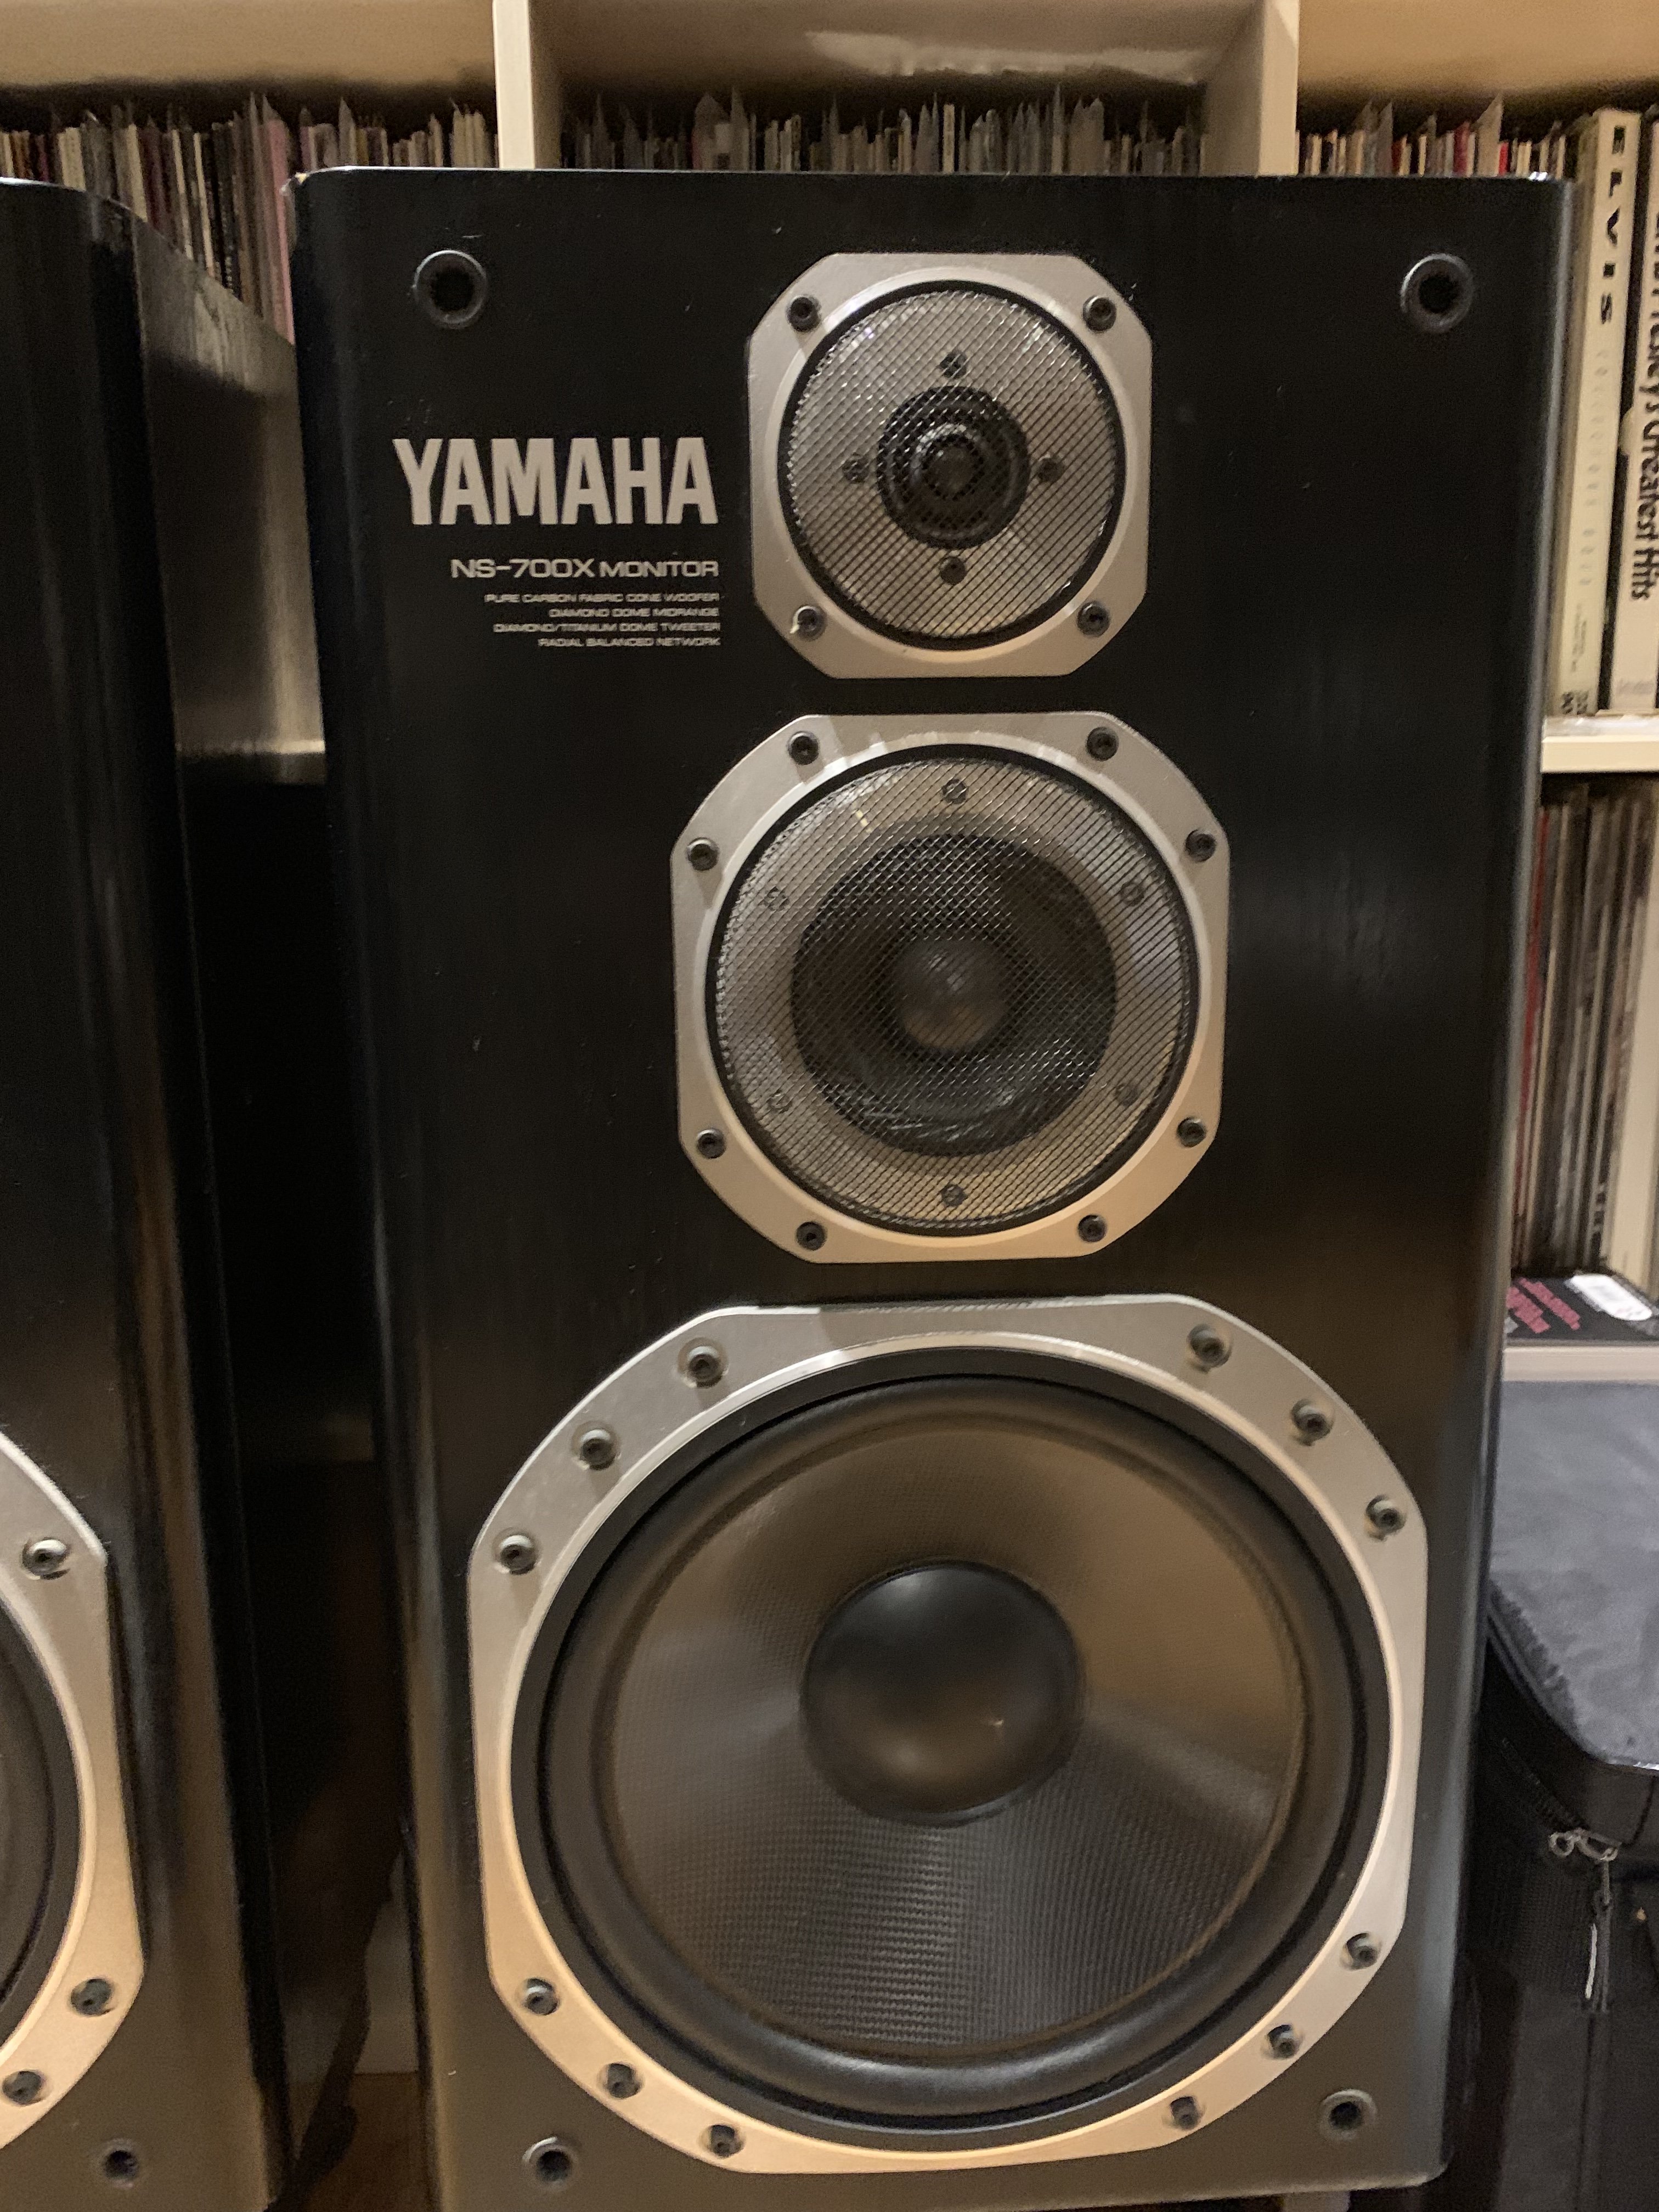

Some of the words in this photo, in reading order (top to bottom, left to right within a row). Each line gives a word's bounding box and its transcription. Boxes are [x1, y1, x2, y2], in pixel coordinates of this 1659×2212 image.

[1600, 126, 1626, 324] ELVIS
[392, 436, 719, 526] YAMAHA
[450, 558, 596, 578] NS-700X
[599, 561, 719, 578] MONITOR
[1631, 548, 1659, 600] Hits
[484, 594, 520, 603] PURE
[522, 594, 577, 603] CARBON
[578, 594, 624, 602] FABRIC
[663, 593, 720, 602] WOOFER
[549, 608, 610, 617] DIAMOND
[612, 608, 651, 617] DOME
[652, 608, 720, 617] MIDRANGE
[619, 623, 658, 631] DOME
[660, 623, 721, 631] TWEETER
[538, 638, 584, 647] RADIAL
[585, 638, 654, 647] BALANCED
[656, 637, 721, 647] NETWORK
